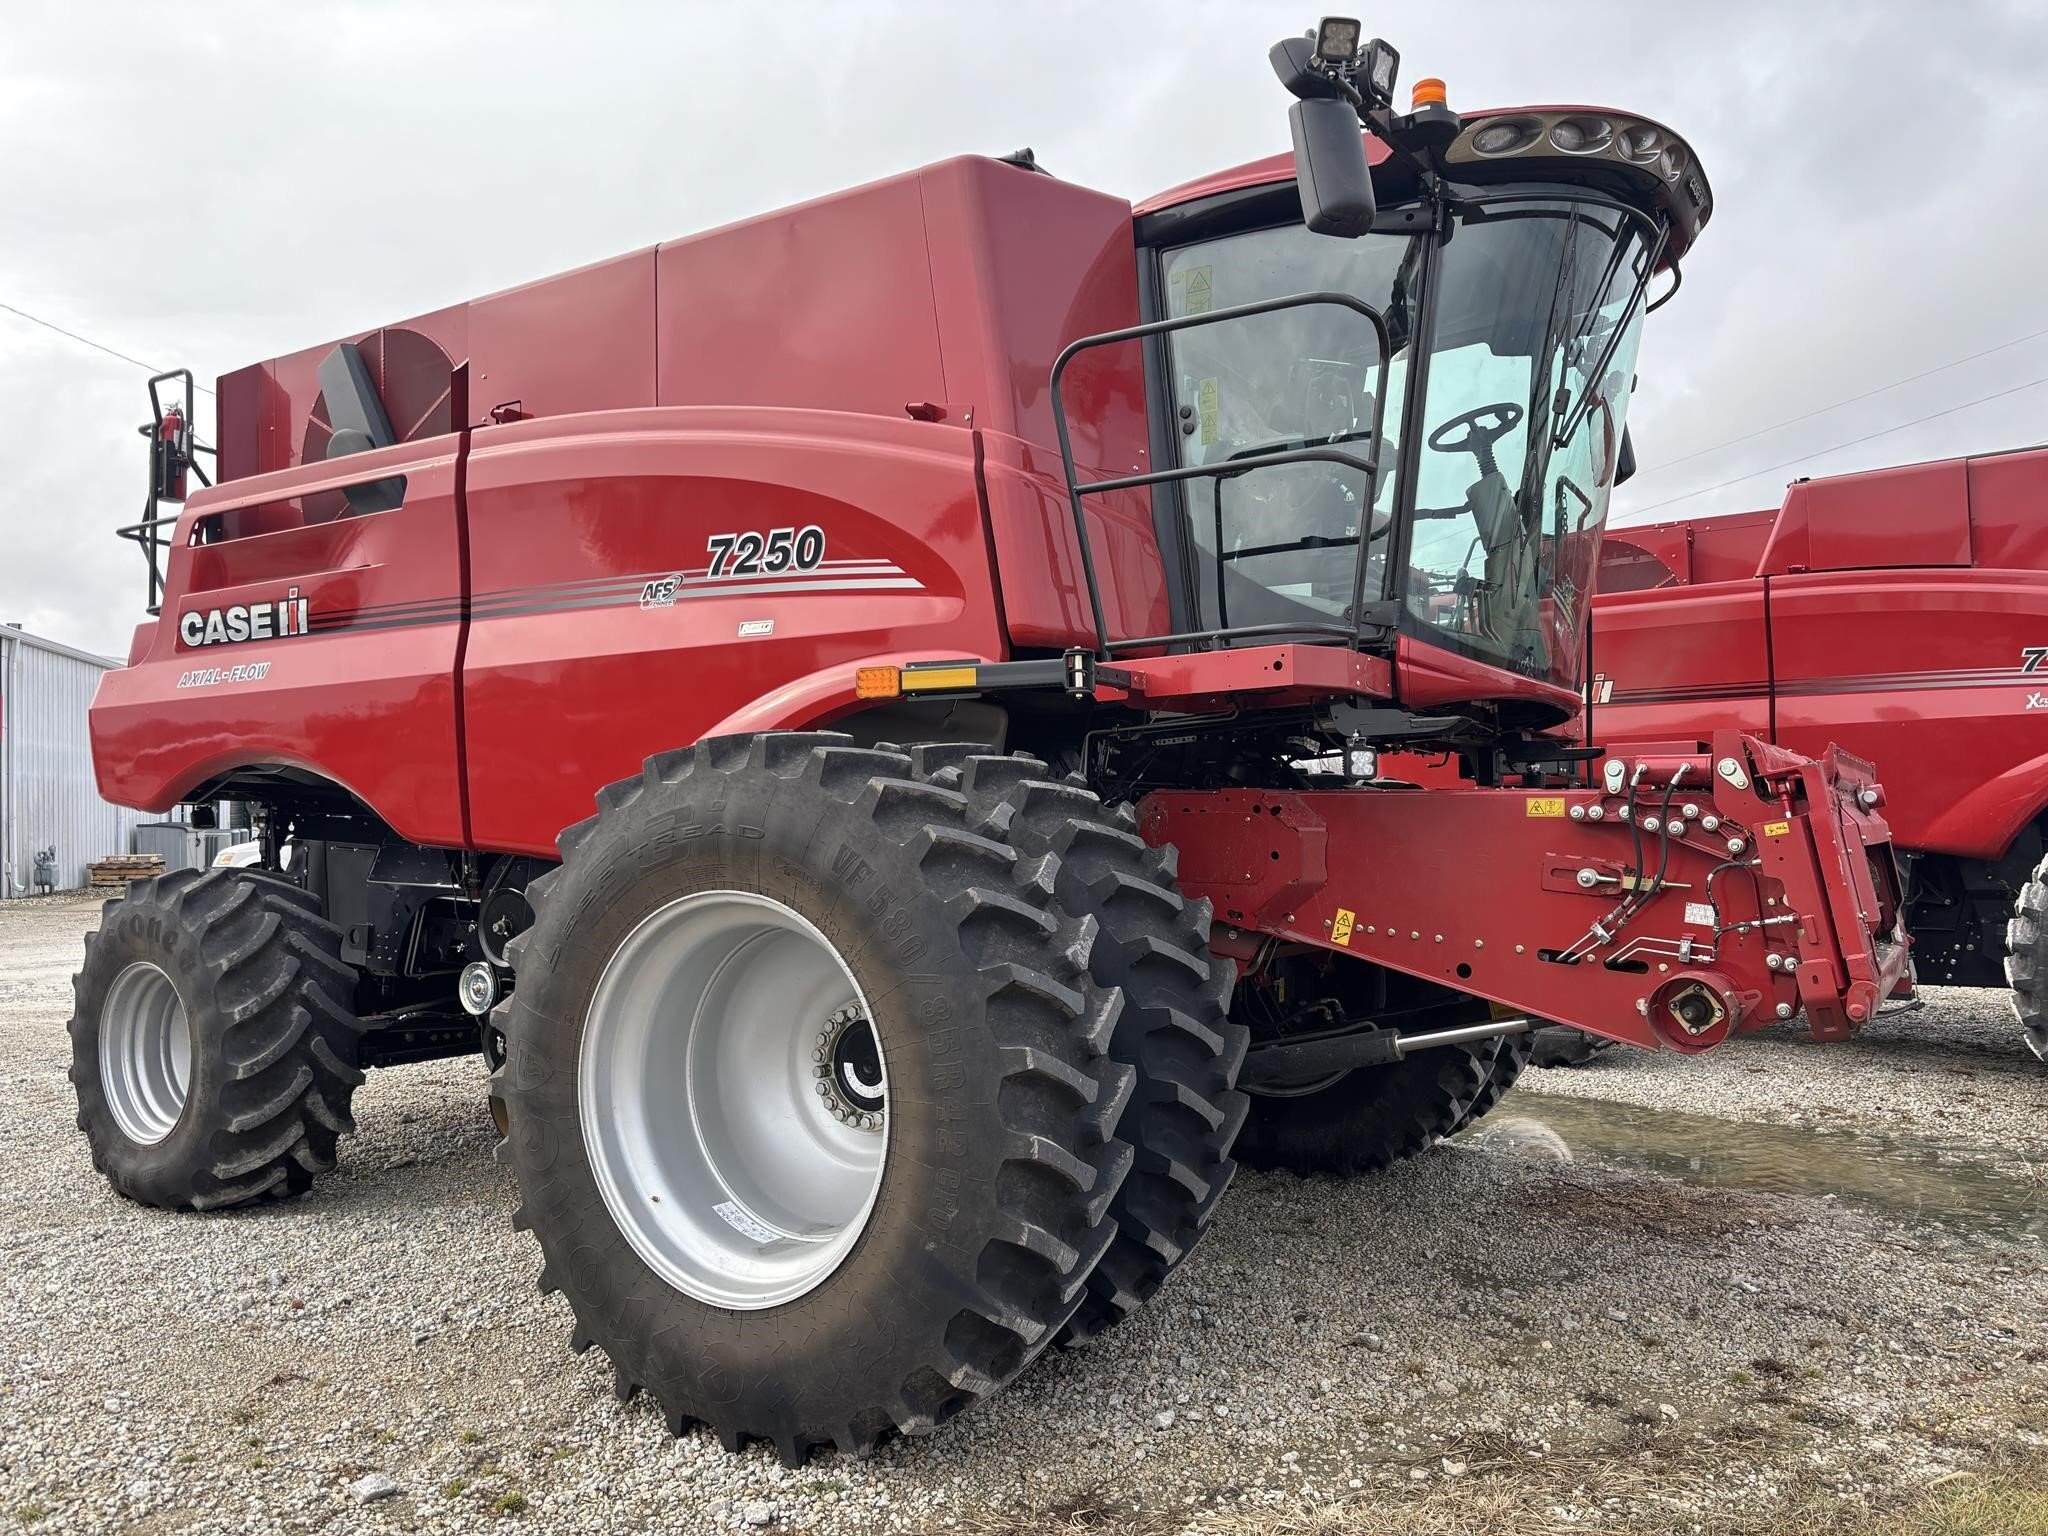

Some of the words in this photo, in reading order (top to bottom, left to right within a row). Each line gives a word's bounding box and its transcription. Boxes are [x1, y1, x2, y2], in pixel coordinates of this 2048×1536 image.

[706, 525, 825, 579] 7250
[640, 580, 677, 602] AFS
[180, 605, 274, 647] CASE
[177, 662, 271, 688] AXIAL-FLOW
